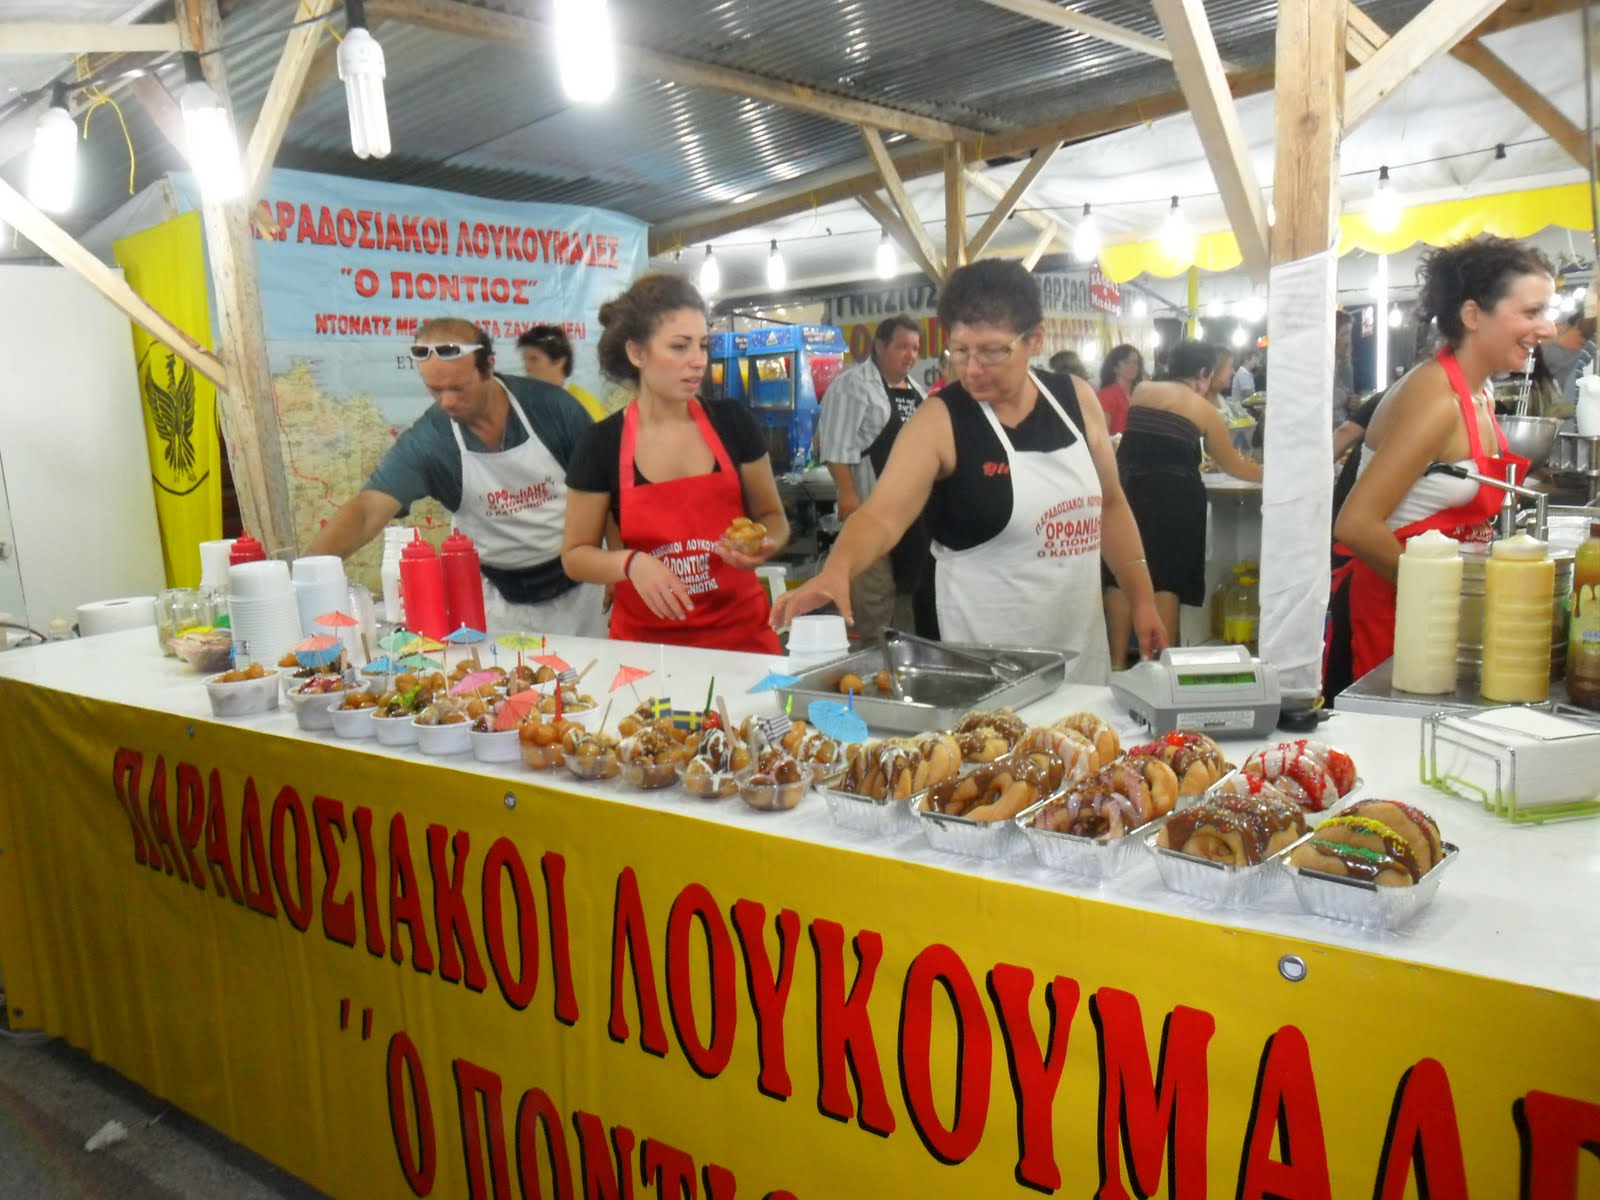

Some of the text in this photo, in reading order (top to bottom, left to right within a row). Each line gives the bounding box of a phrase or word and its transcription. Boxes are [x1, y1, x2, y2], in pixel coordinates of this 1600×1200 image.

[251, 199, 620, 269] ΑΡΑΔΟΣΙΑΚΟΙ ΛΟΥΚΟΥΜΑΔΕΣ
[1037, 550, 1046, 558] Ο
[113, 747, 579, 1025] ΠΑΡΑΔΟΣΙΑΚΟΙ
